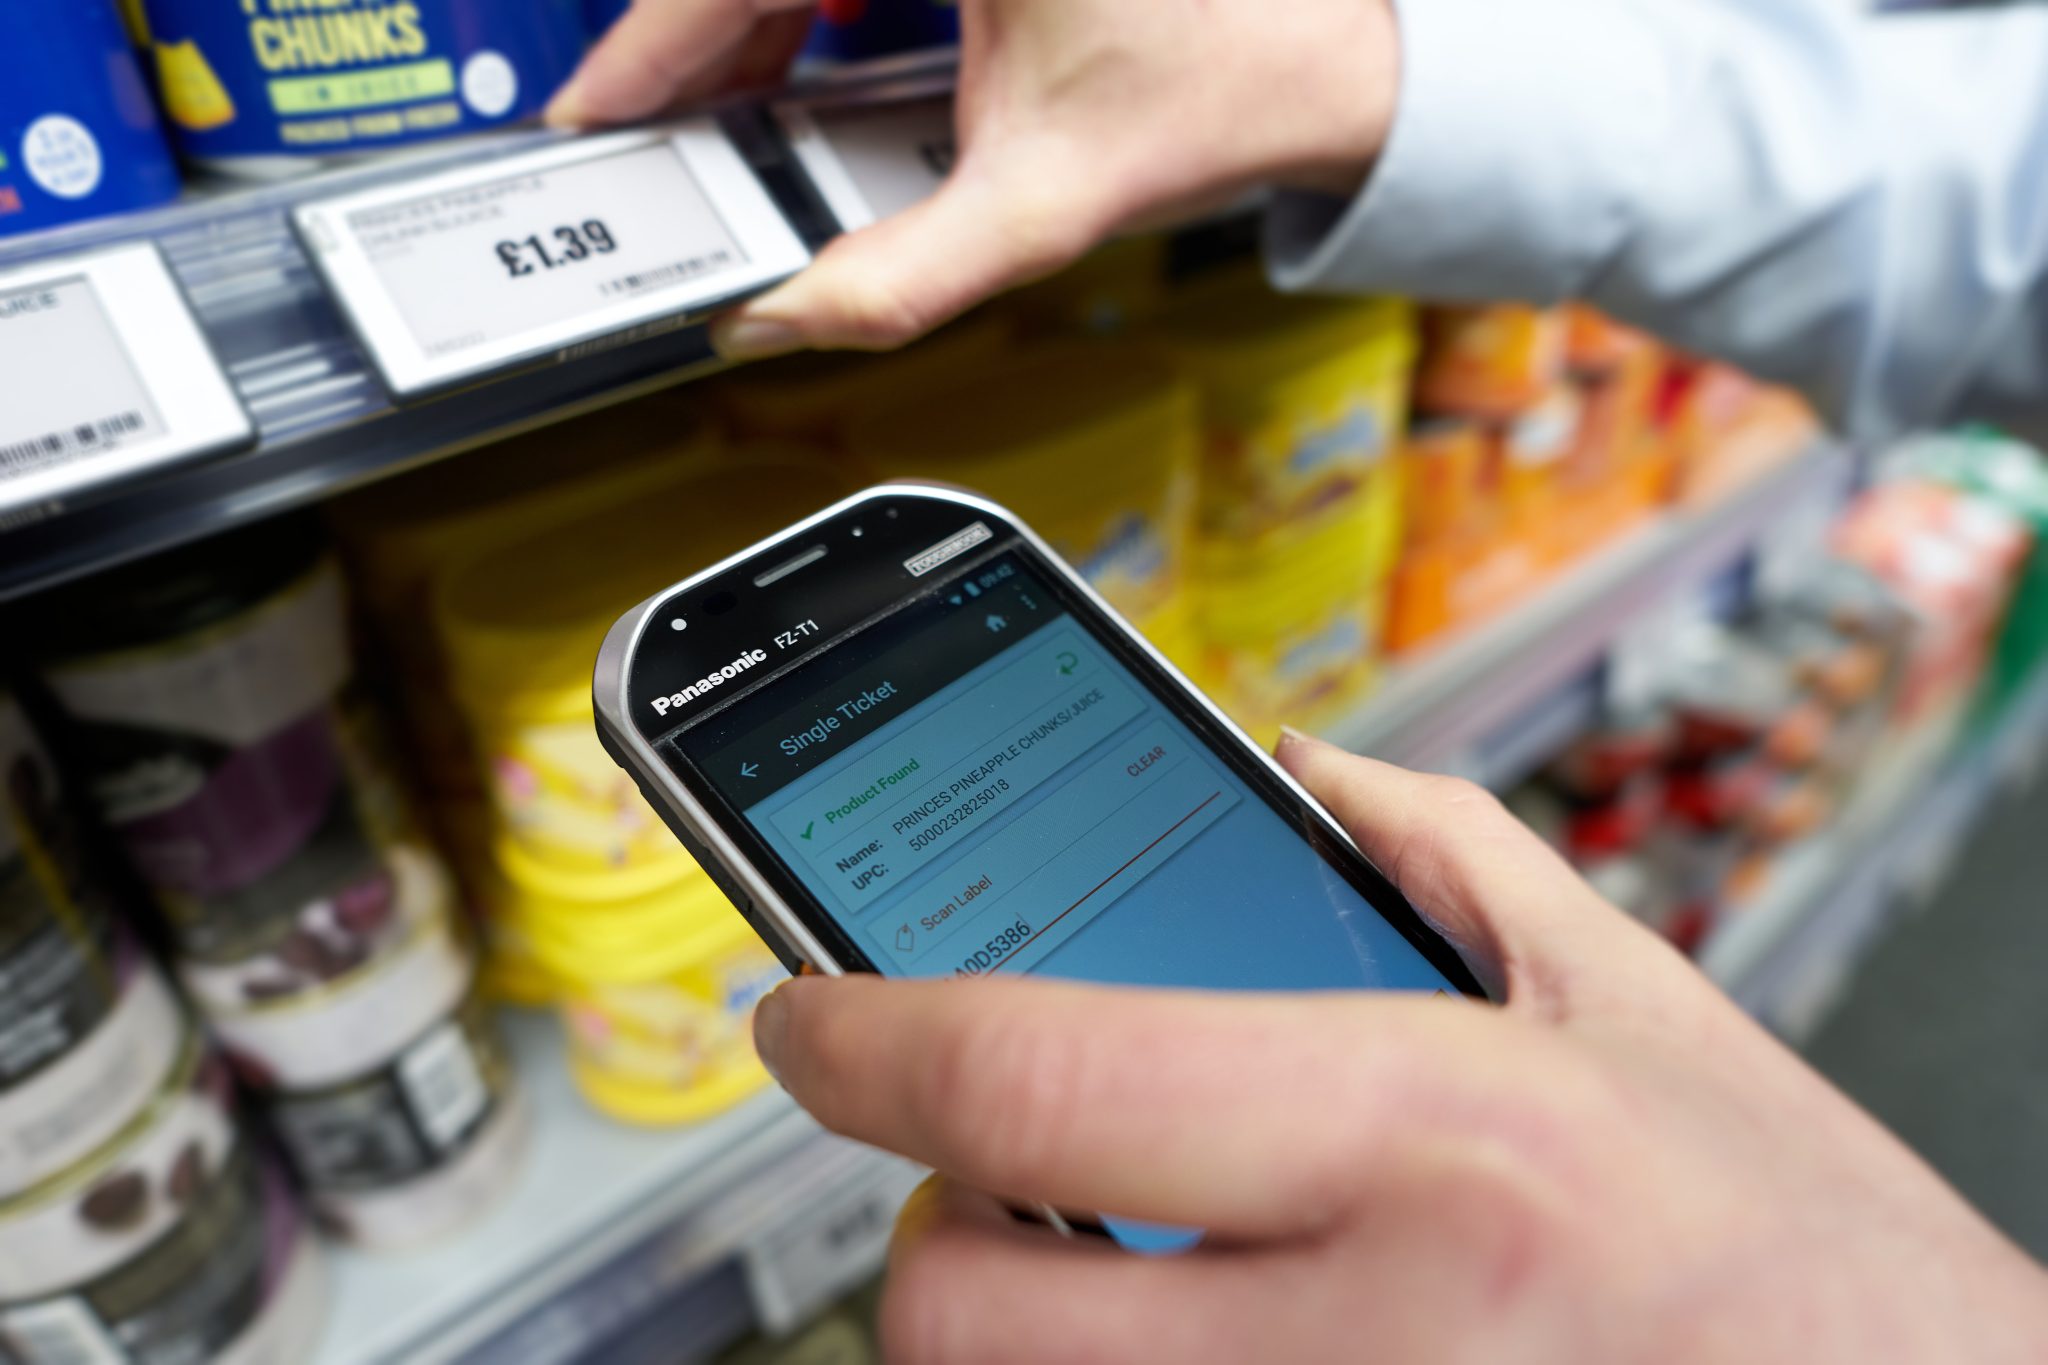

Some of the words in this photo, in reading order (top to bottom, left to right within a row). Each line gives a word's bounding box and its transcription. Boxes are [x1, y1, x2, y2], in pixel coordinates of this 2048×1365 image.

[251, 2, 427, 70] CHUNKS
[494, 218, 618, 278] £1.39
[651, 649, 767, 716] Panasonic
[773, 619, 819, 650] FZ-T1
[779, 718, 841, 756] Single
[836, 680, 898, 720] Ticket
[824, 784, 881, 824] Product
[877, 757, 921, 790] Found
[835, 839, 884, 873] Name:
[892, 791, 952, 835] PRINCES
[950, 744, 1022, 796] PINEAPPLE
[1018, 687, 1106, 750] CHUNKS/JUICE
[1126, 745, 1168, 778] CLEAR
[851, 864, 890, 891] UPC:
[908, 778, 1010, 851] 5000232825018
[920, 902, 958, 931] Scan
[953, 874, 993, 907] Label
